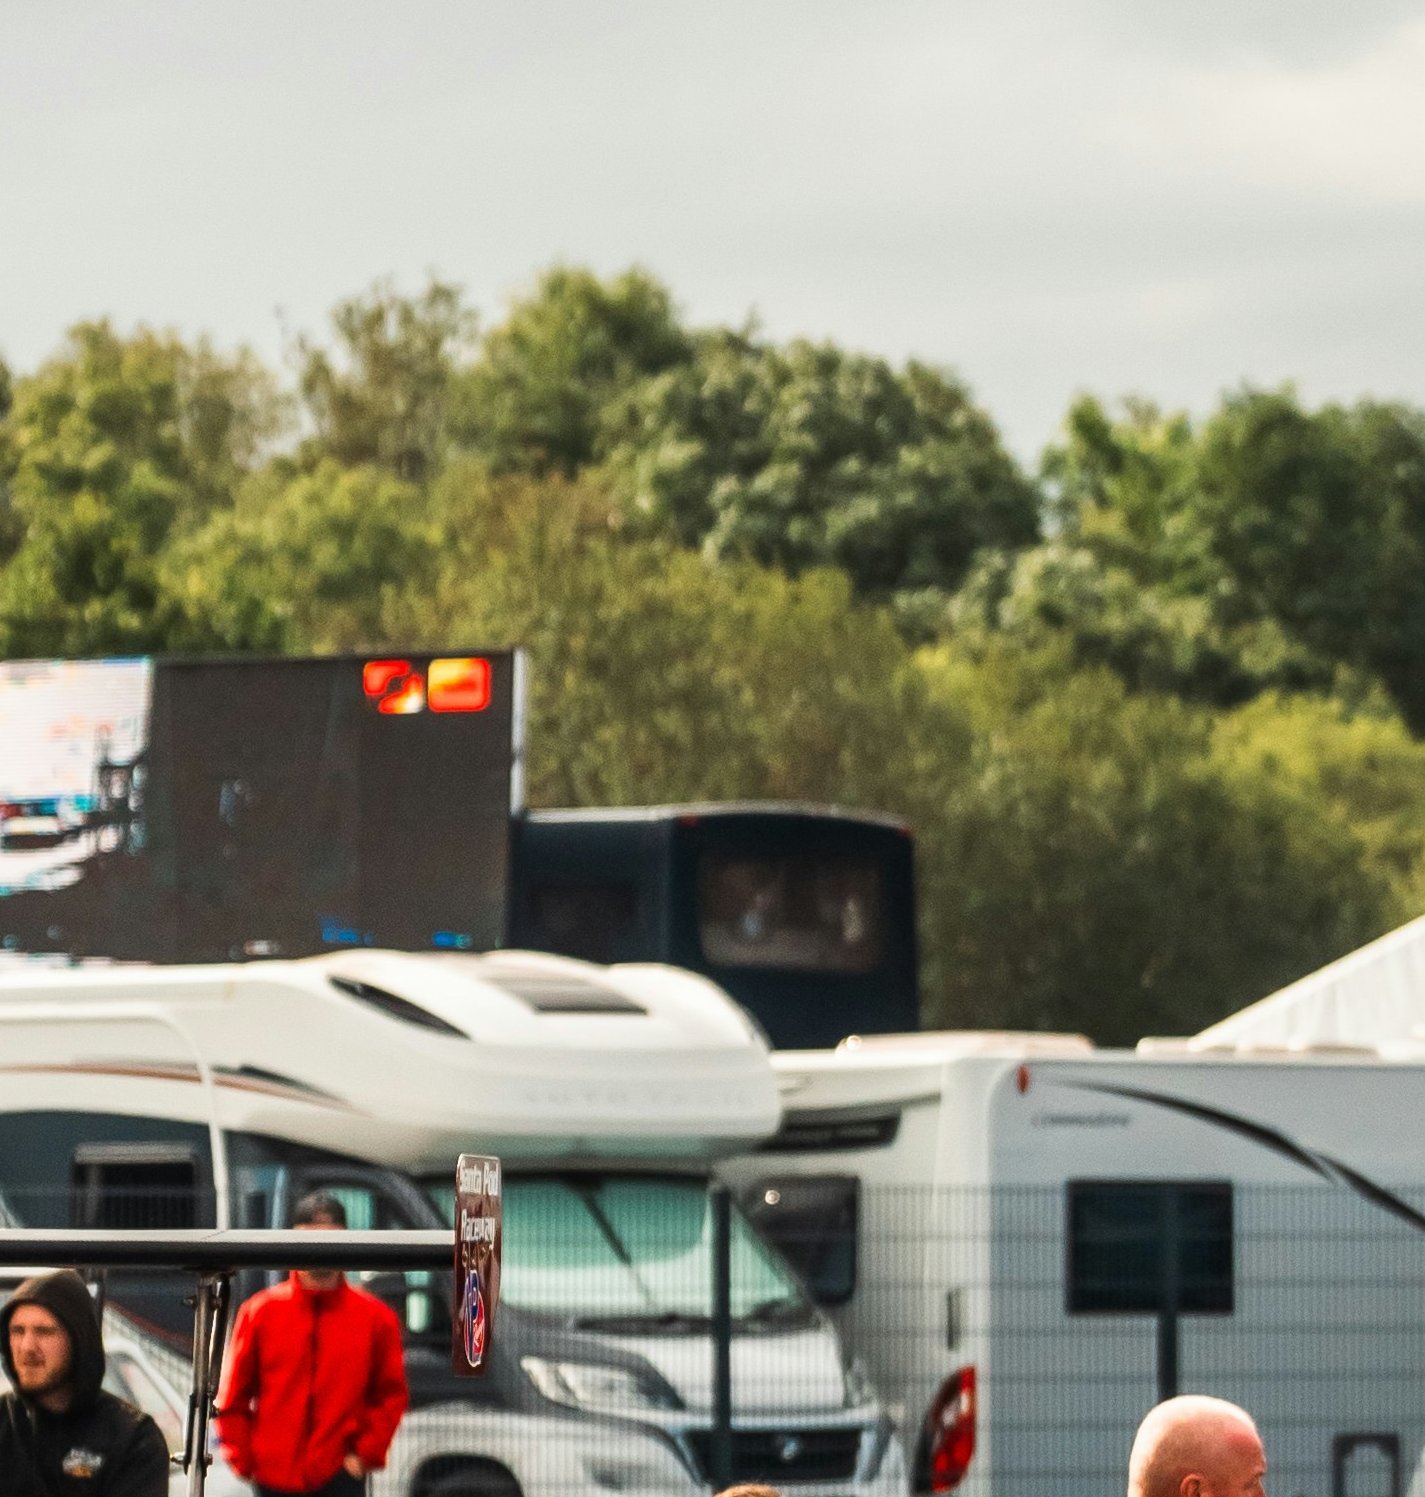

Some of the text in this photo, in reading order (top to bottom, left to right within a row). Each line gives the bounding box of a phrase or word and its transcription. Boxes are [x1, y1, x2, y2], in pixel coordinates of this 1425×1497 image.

[459, 1158, 499, 1197] Santa Pod
[461, 1208, 496, 1250] Raceway
